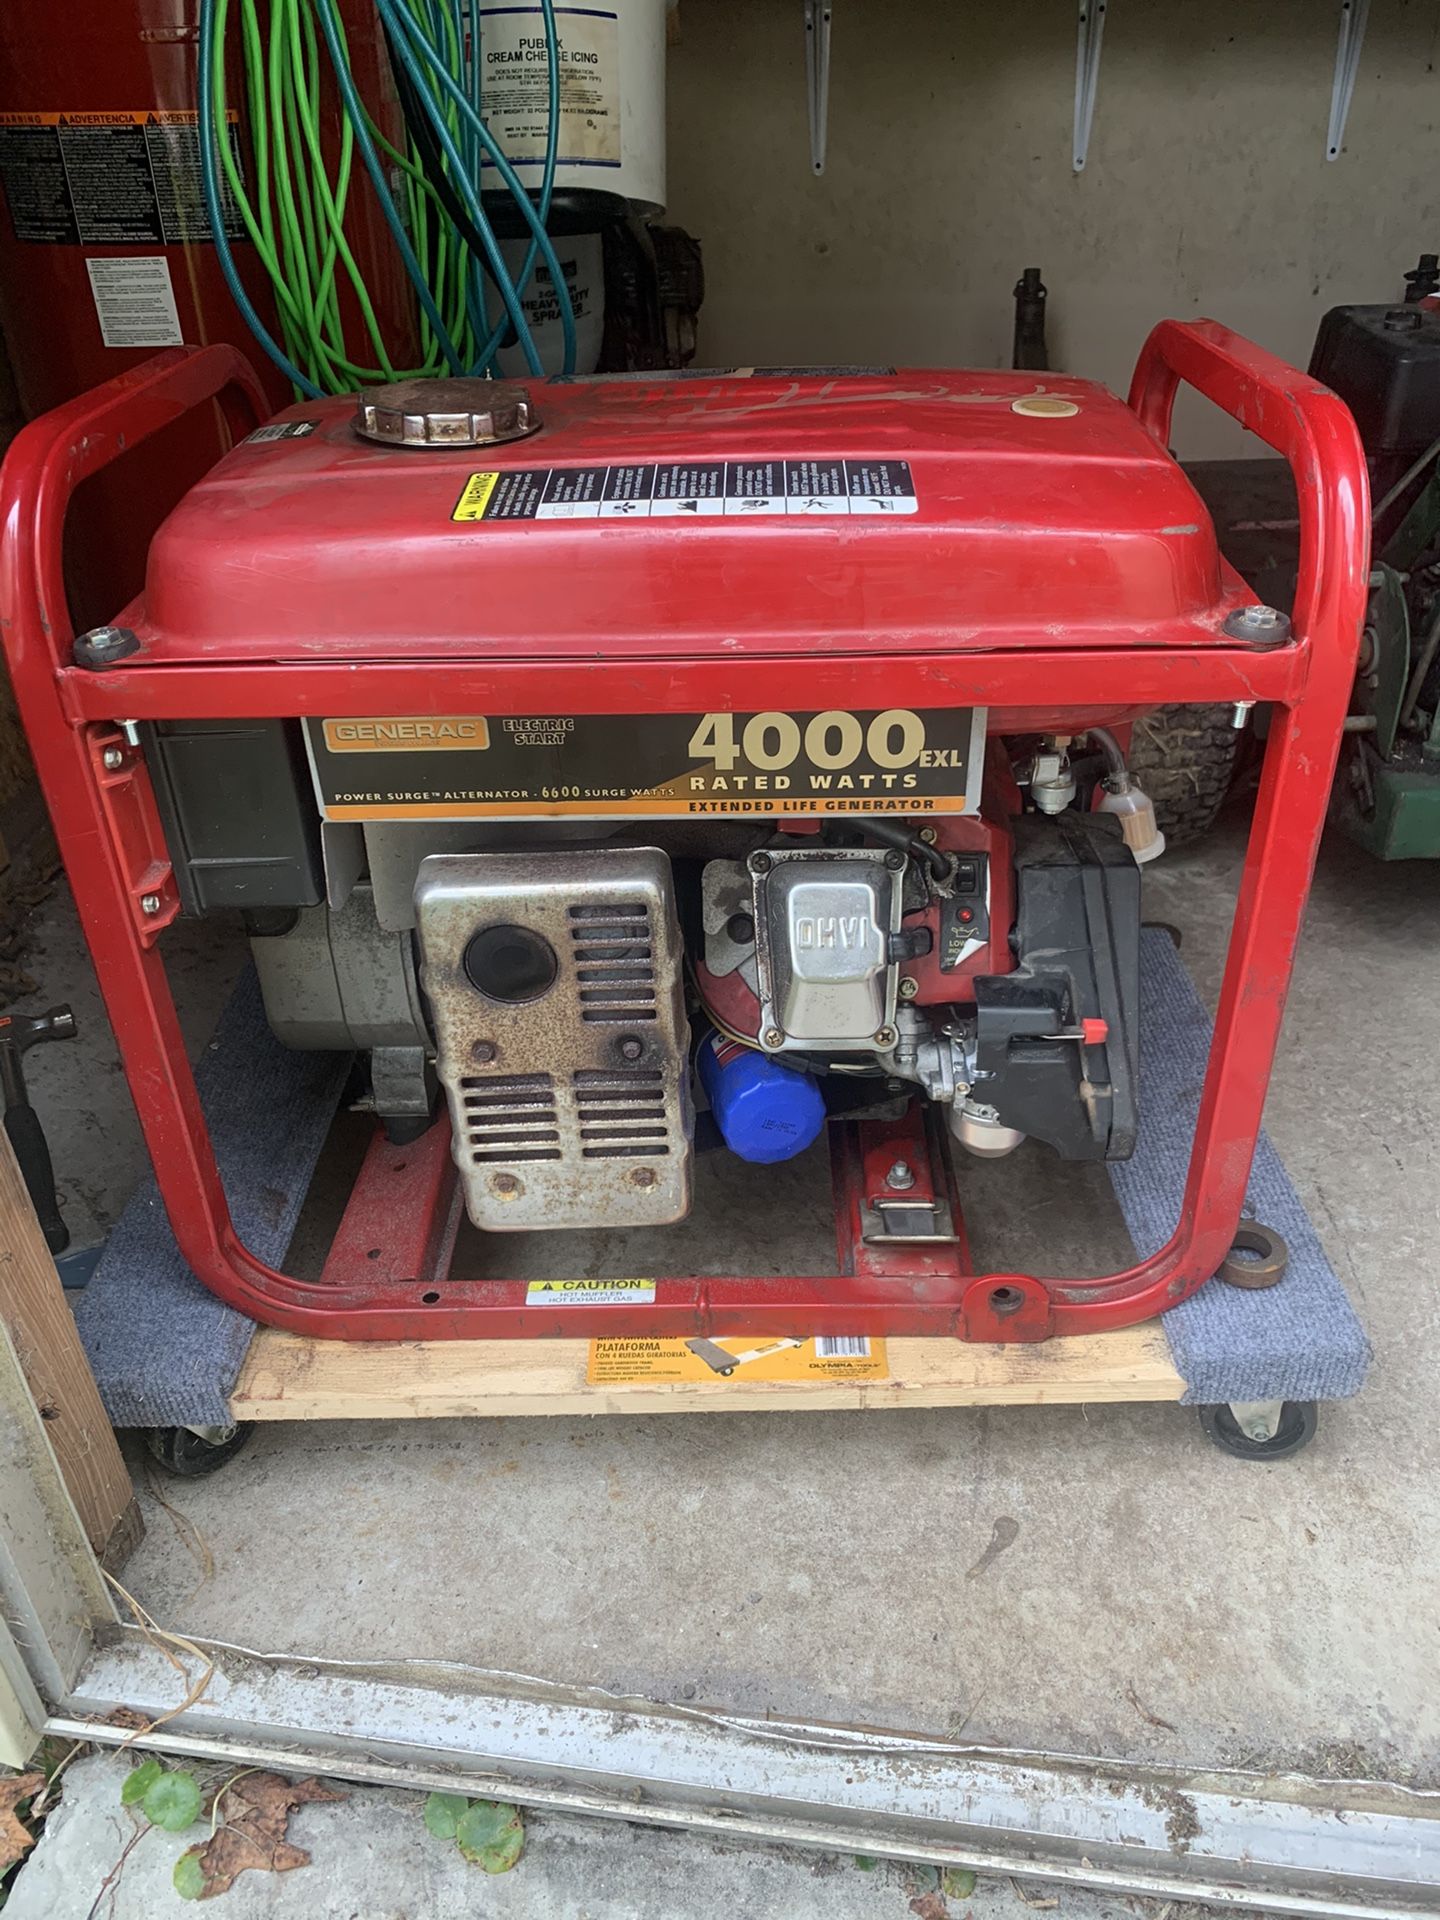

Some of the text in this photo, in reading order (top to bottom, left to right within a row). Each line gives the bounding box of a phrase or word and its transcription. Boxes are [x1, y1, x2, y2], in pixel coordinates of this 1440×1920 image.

[519, 38, 563, 49] PUBX
[487, 51, 598, 63] CREAM CHEE ICING
[69, 114, 136, 124] ADVERTENCIA
[532, 303, 583, 322] SPRAER
[462, 473, 493, 505] WARNING
[335, 709, 926, 771] GENERAC ELECTRIC 4000
[514, 732, 567, 745] START
[919, 749, 963, 768] EXL
[690, 774, 918, 790] RATED WATTS
[335, 793, 382, 801] POWER
[444, 790, 529, 799] ALTERNATOR
[542, 786, 580, 798] 6600
[584, 788, 626, 797] SURGE
[630, 788, 675, 796] WATTS
[689, 800, 935, 812] EXTENDED LIFE GENERATOR
[562, 1280, 641, 1290] CAUTION
[596, 1342, 660, 1351] PLATAFORMA
